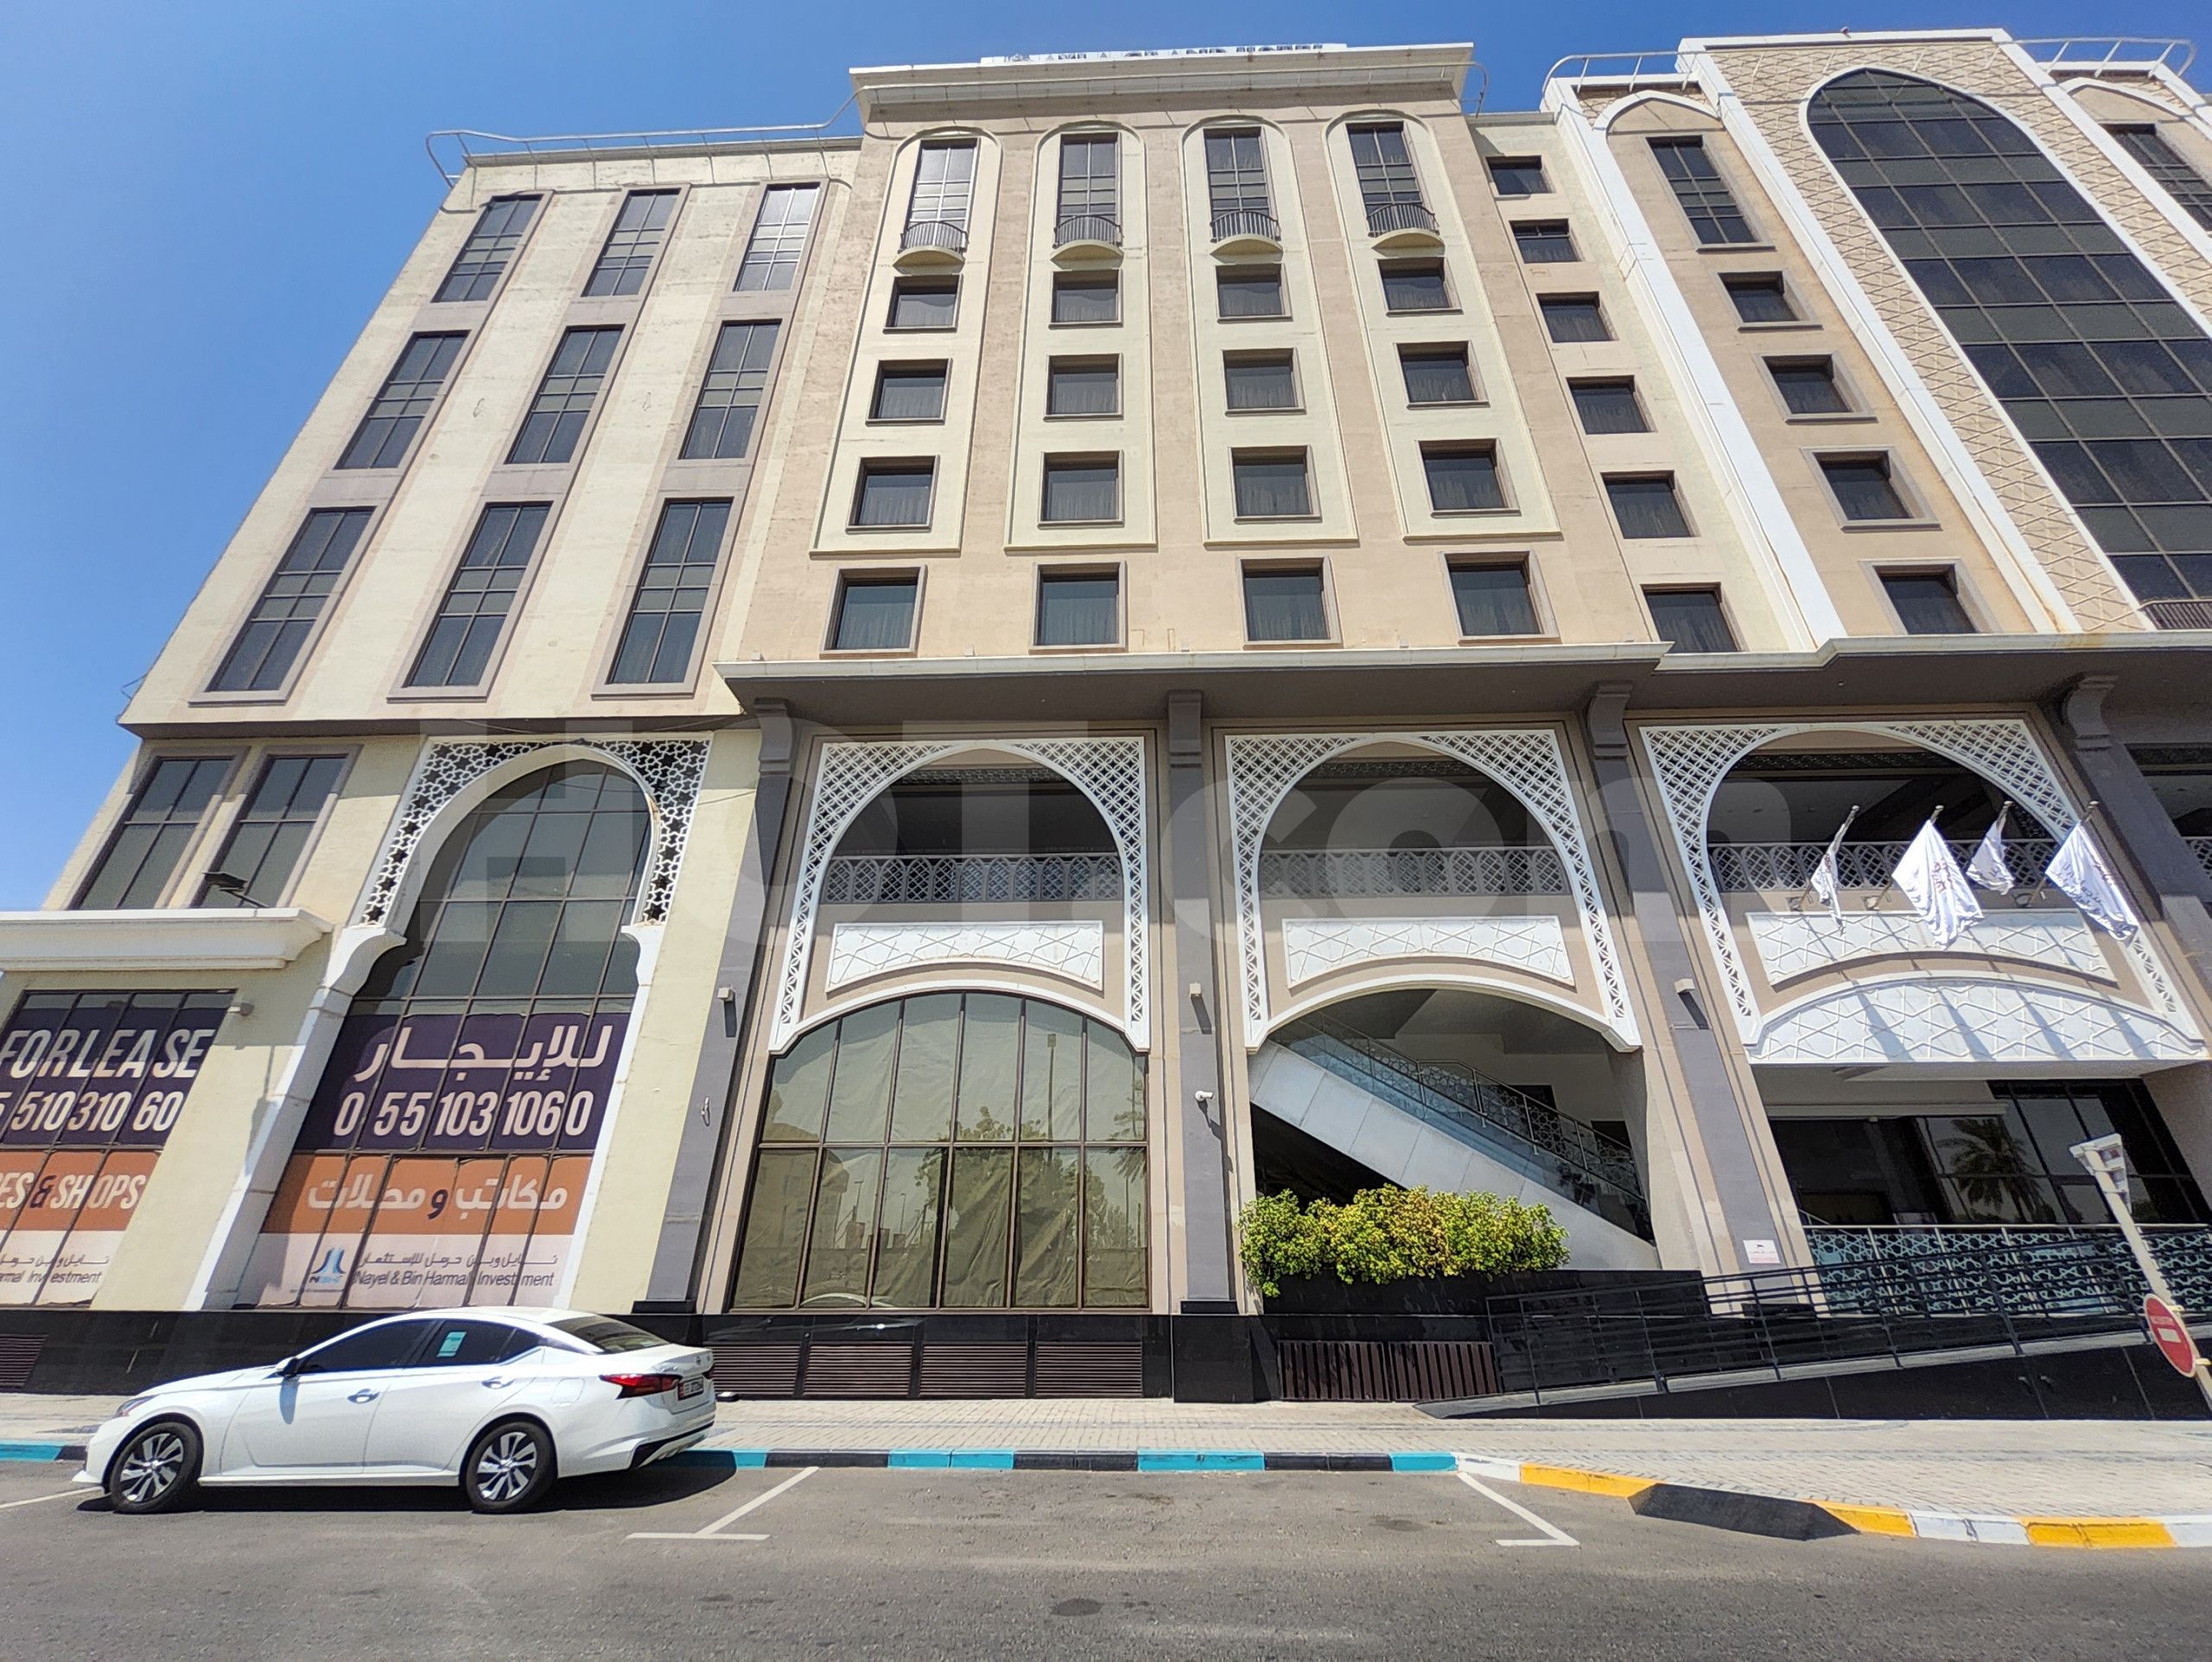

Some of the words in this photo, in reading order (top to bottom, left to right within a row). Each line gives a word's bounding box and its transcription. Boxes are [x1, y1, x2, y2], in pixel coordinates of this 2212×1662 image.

[353, 1025, 613, 1082] للإيجار
[0, 1172, 35, 1209] ES
[29, 1175, 57, 1209] &
[49, 1174, 146, 1209] SHOPS
[308, 1174, 426, 1210] محلات
[428, 1188, 448, 1220] و
[455, 1175, 568, 1220] مكاتب
[391, 1270, 400, 1285] &
[401, 1270, 423, 1285] Bin
